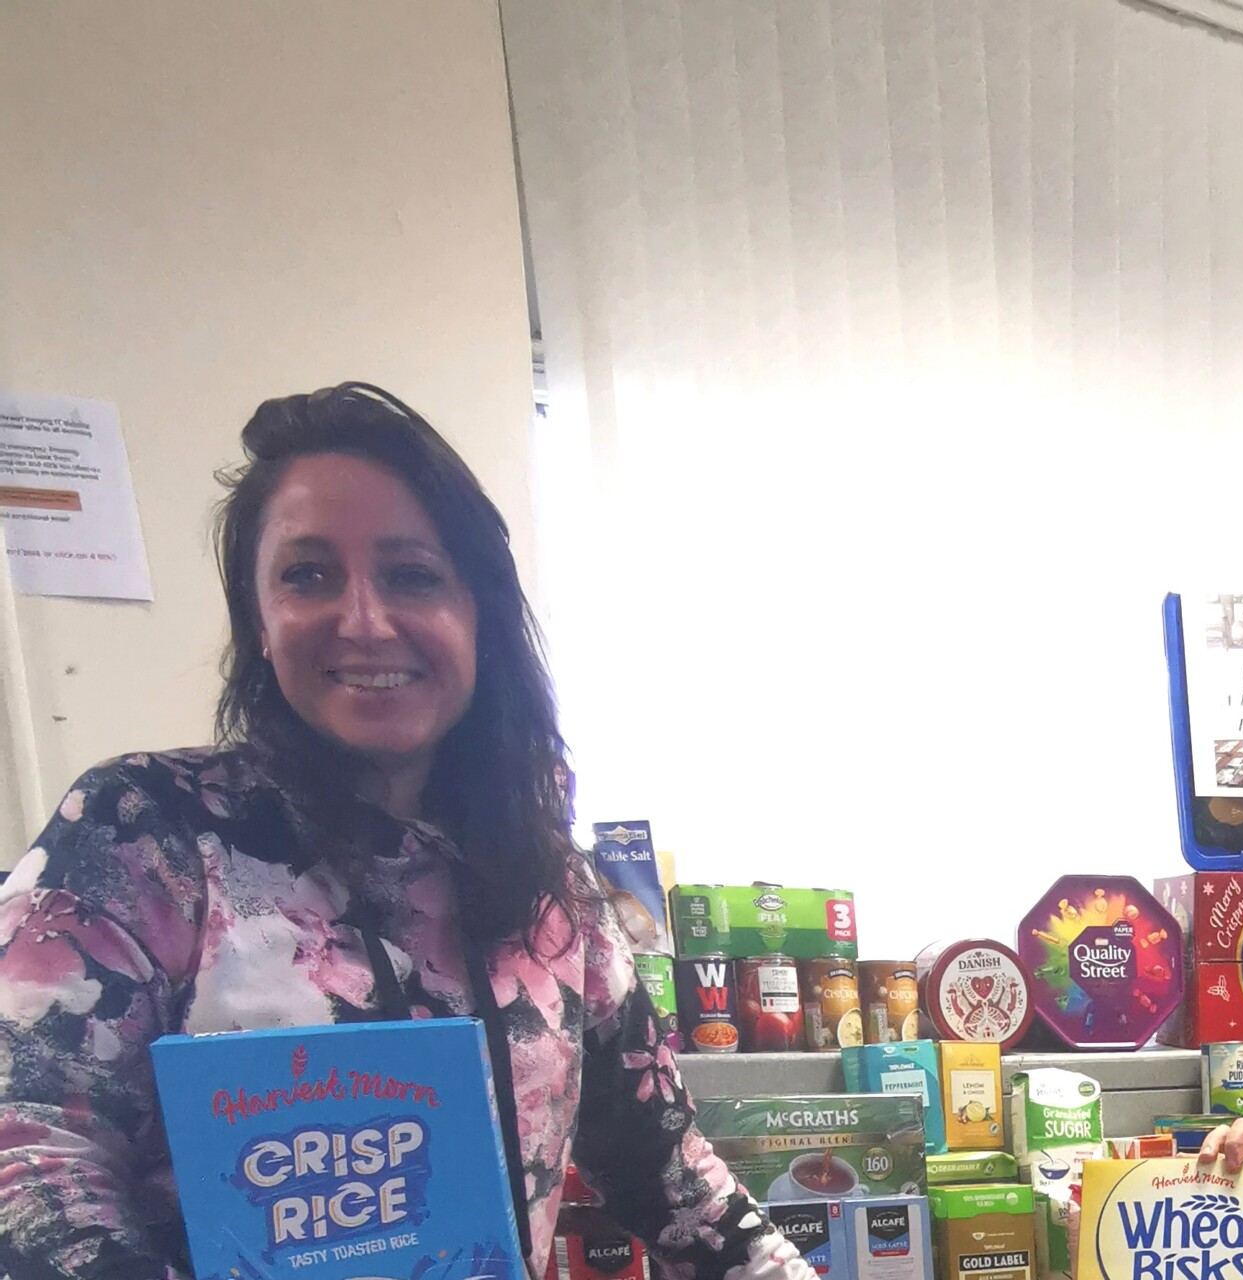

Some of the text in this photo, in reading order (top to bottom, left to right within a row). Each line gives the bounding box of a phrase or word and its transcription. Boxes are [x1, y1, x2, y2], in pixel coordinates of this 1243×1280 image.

[600, 850, 652, 862] Table Salt
[1209, 876, 1242, 929] Merry
[757, 912, 788, 924] PEAS
[832, 903, 851, 930] 3
[1073, 944, 1132, 966] Quality
[958, 957, 1001, 971] DANISH
[1080, 962, 1128, 978] Street
[693, 963, 727, 988] W
[647, 982, 664, 996] AS
[696, 987, 728, 1011] W
[211, 1066, 441, 1126] Harvest Morn
[1042, 1107, 1092, 1120] Granulated
[1044, 1120, 1092, 1139] SUGAR
[751, 1138, 813, 1148] ORIGINAL
[243, 1121, 424, 1190] CRISP
[865, 1156, 889, 1172] 160
[1151, 1172, 1236, 1190] Harvest Morn
[272, 1176, 408, 1245] RICE
[870, 1216, 905, 1229] ALCAFÉ
[287, 1232, 419, 1268] TASTY TOASTED RICE
[588, 1243, 631, 1259] ALCAFÉ
[807, 1254, 827, 1265] ATTE
[962, 1253, 1026, 1269] GOLD LABEL
